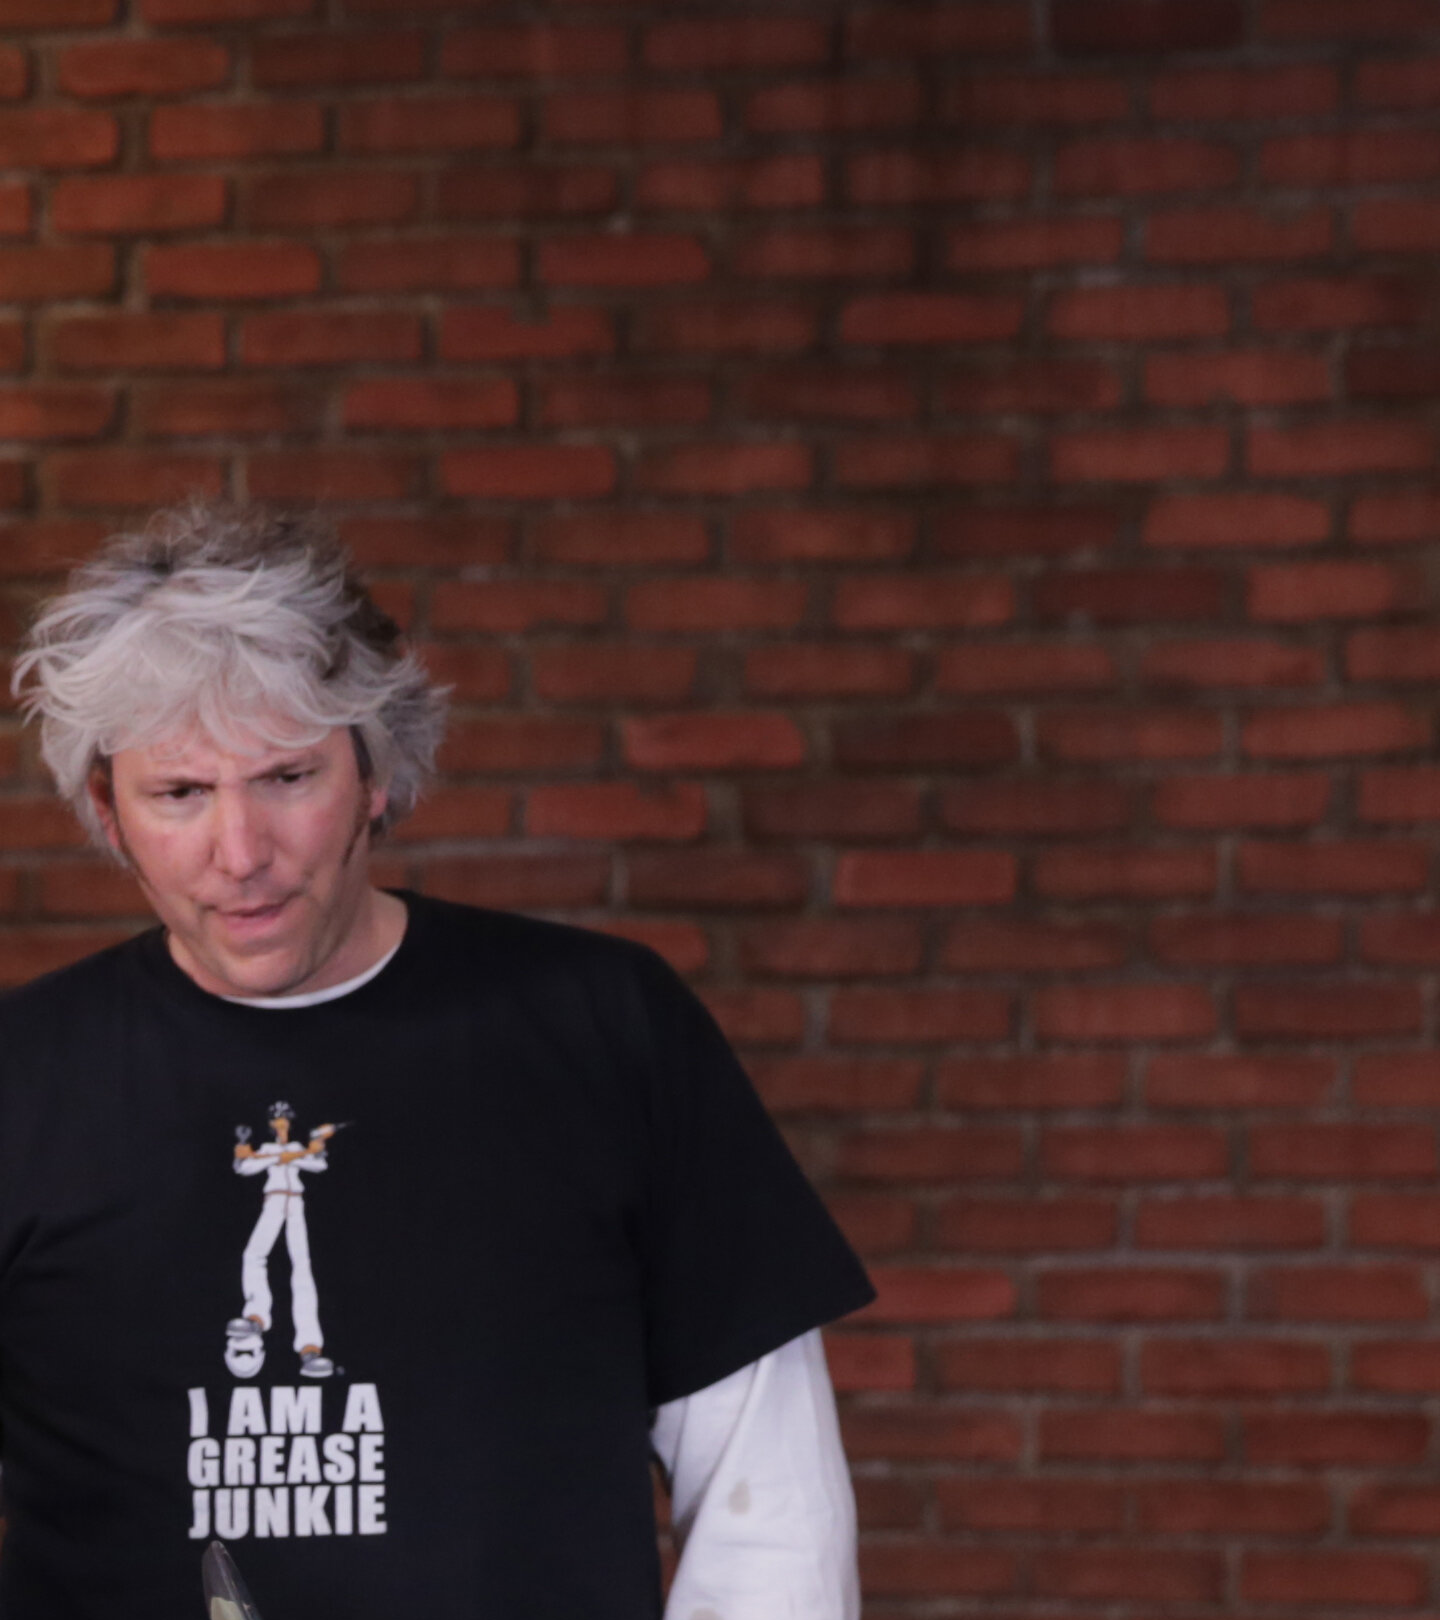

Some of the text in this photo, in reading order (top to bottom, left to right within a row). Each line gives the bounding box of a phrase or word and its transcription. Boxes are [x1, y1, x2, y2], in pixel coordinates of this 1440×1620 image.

[188, 1383, 384, 1438] I AM A
[187, 1433, 385, 1488] GREASE
[188, 1484, 387, 1540] JUNKIE
